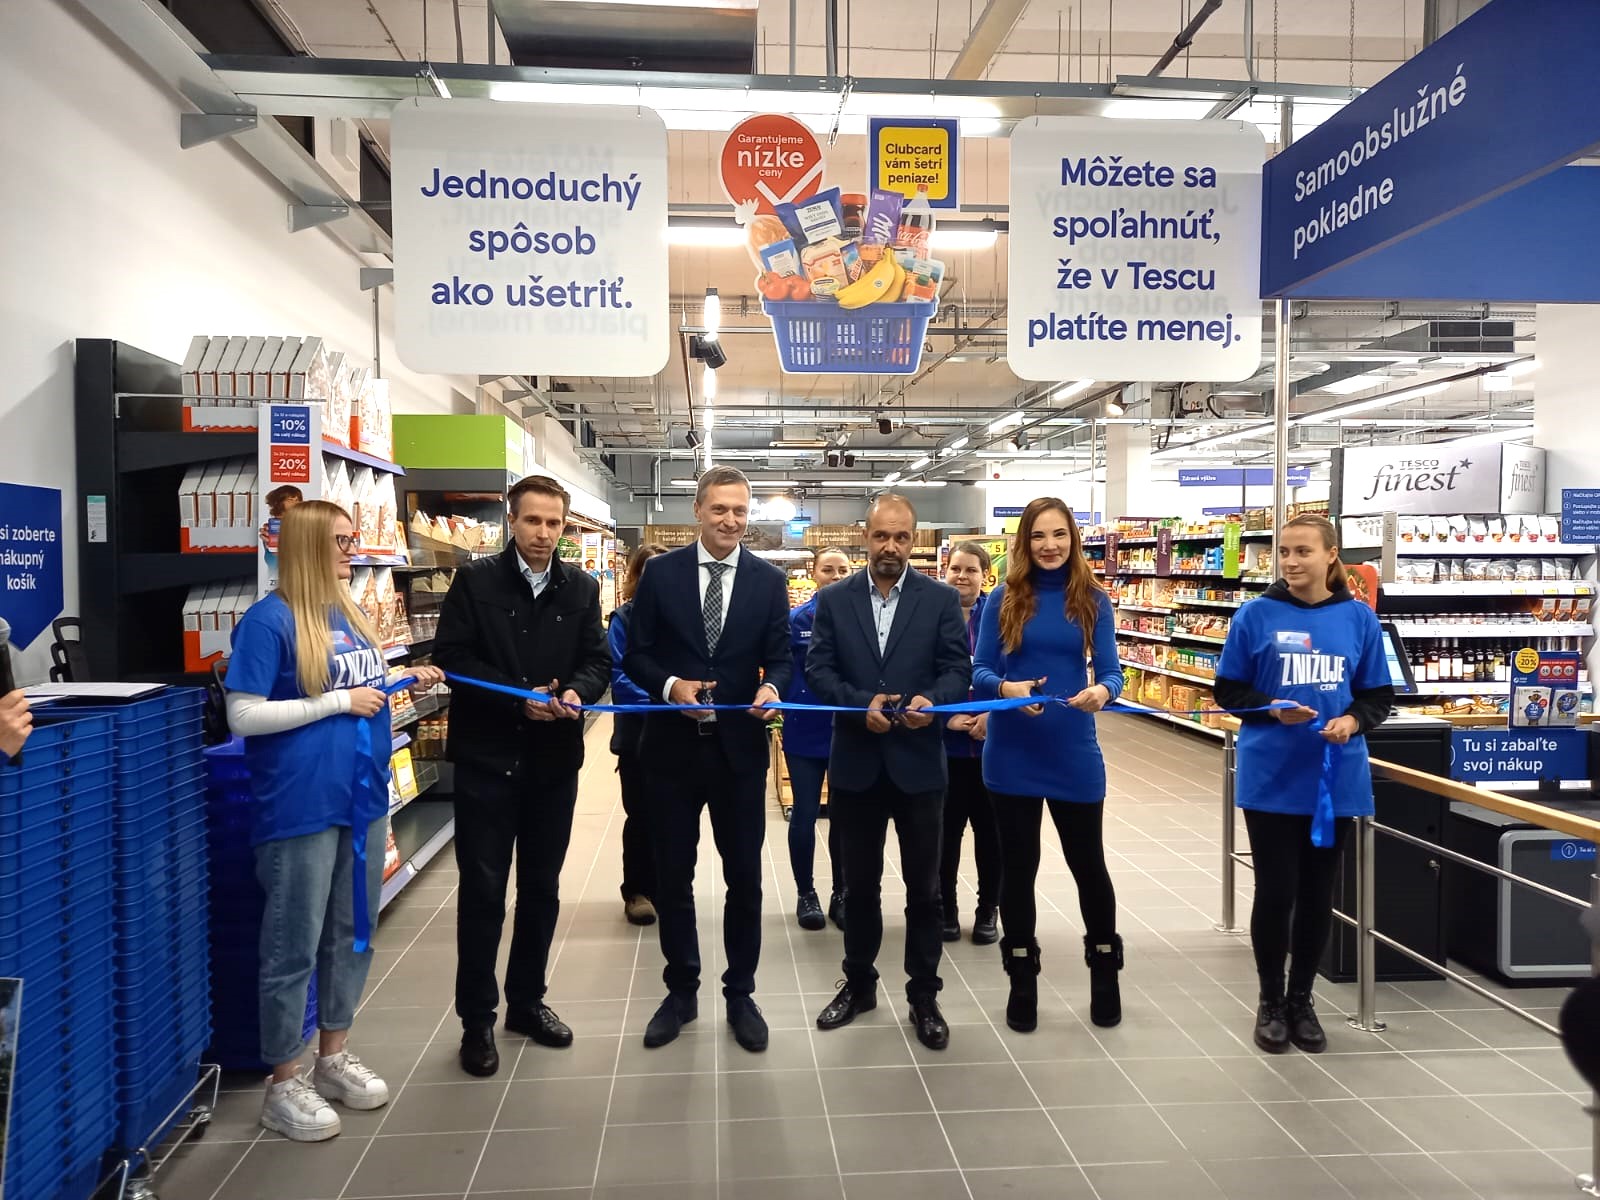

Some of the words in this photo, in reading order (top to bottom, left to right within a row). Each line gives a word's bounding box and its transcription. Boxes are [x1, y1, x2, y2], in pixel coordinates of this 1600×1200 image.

[737, 133, 804, 145] Garantujeme
[1294, 62, 1467, 202] Samoobslužné
[737, 146, 805, 168] nízke
[885, 143, 942, 155] Clubcard
[885, 158, 911, 169] vám
[914, 157, 942, 169] šetrí
[1061, 156, 1174, 187] Môžete
[1183, 166, 1216, 188] sa
[758, 168, 783, 179] ceny
[887, 173, 939, 186] peniaze!
[420, 168, 642, 211] Jednoduchý
[1052, 208, 1220, 245] spoľahnúť,
[1293, 177, 1394, 260] pokladne
[469, 221, 596, 260] spôsob
[1056, 259, 1092, 289] že
[1100, 268, 1119, 289] v
[1127, 262, 1215, 290] Tescu
[431, 276, 494, 306] ako
[506, 275, 632, 309] ušetriť.
[1028, 312, 1128, 348] platíte
[1137, 313, 1241, 349] menej.
[274, 419, 306, 431] -10%
[273, 458, 306, 470] -20%
[1399, 459, 1440, 468] TESCO
[1363, 464, 1462, 501] finest
[0, 524, 9, 540] si
[12, 525, 56, 542] zoberte
[7, 573, 36, 590] košík
[1279, 649, 1345, 687] ZNIŽUJE
[1320, 683, 1338, 691] CENY
[1463, 738, 1480, 752] Tu
[1485, 738, 1497, 752] si
[1501, 737, 1558, 752] zabaľte
[1463, 758, 1493, 775] svoj
[1498, 757, 1543, 774] nákup
